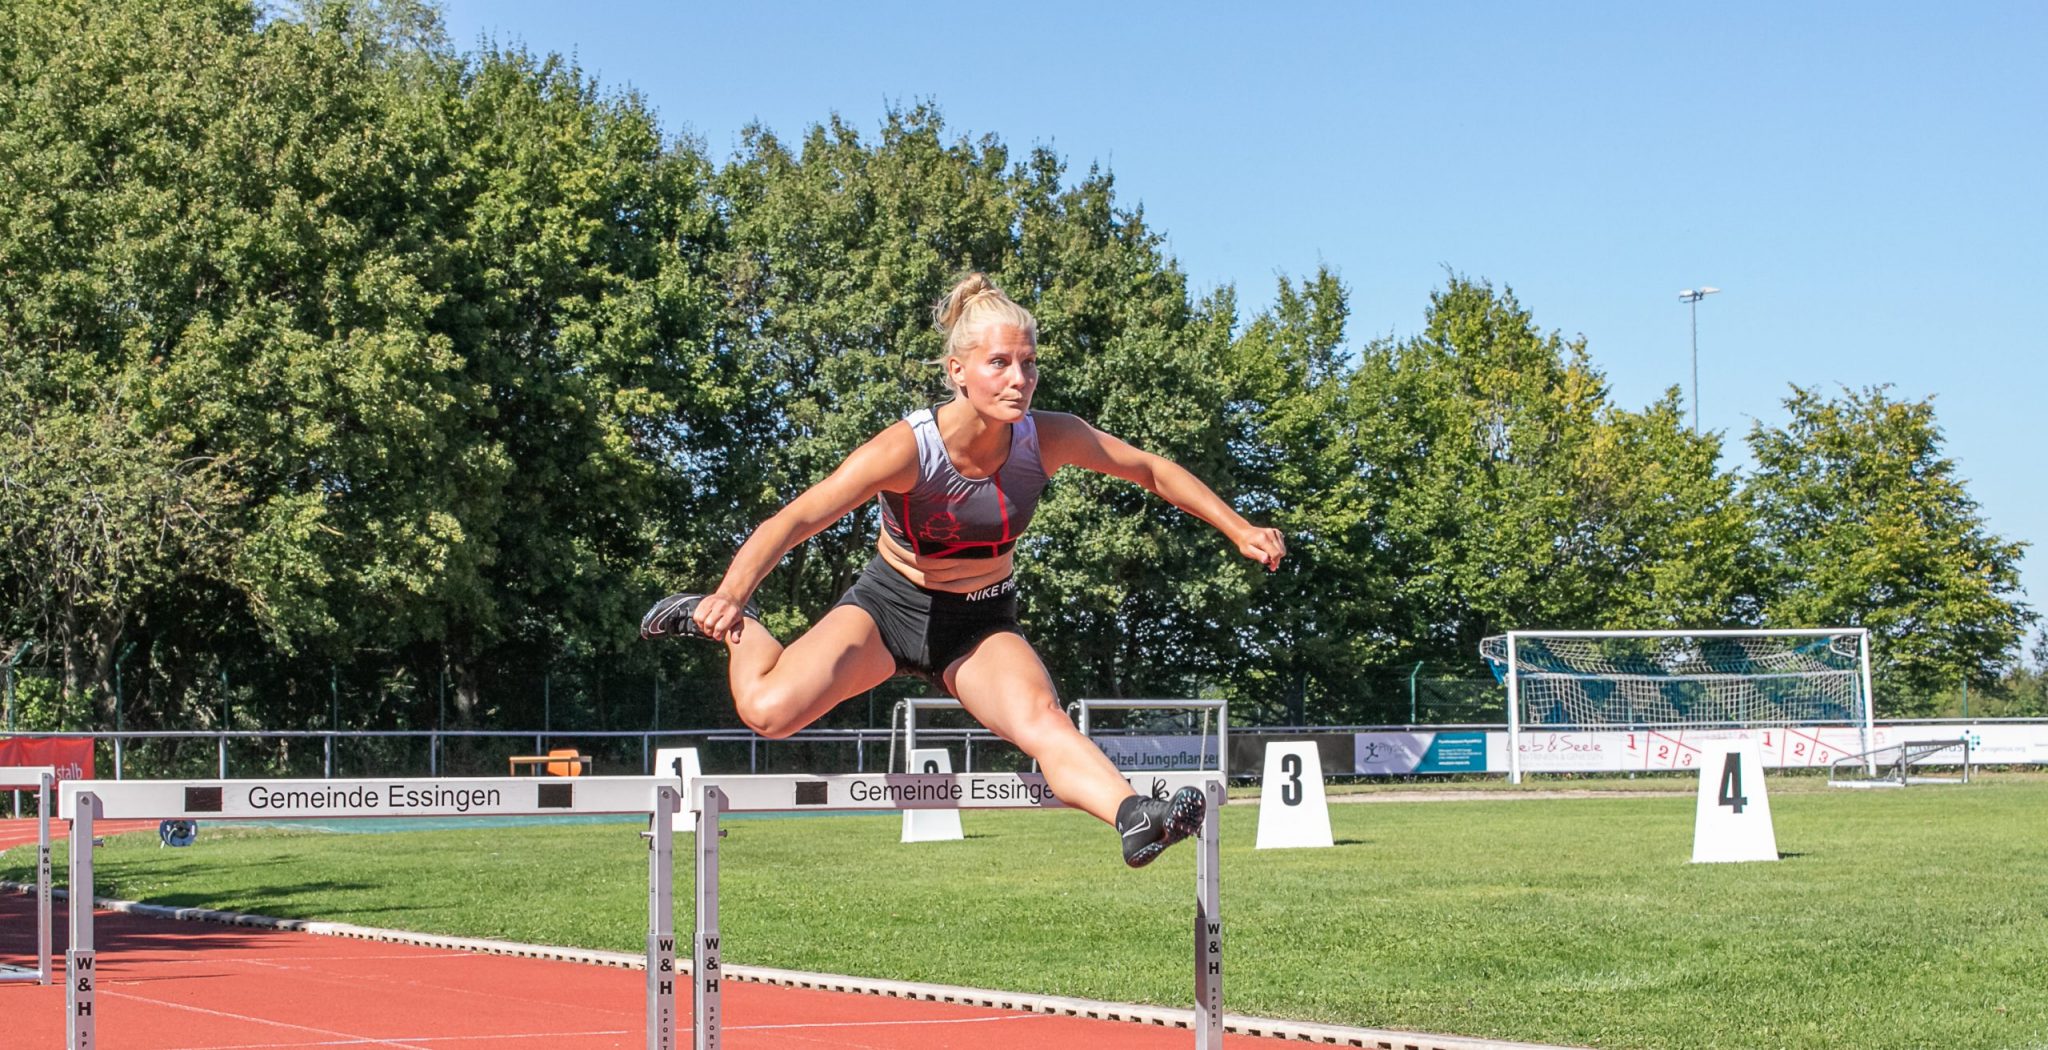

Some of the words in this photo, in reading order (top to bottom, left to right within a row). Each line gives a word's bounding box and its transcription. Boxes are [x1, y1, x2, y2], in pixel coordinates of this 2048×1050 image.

[966, 585, 1000, 602] NIKE
[1001, 579, 1016, 594] PR
[1547, 732, 1558, 753] &
[1560, 732, 1603, 752] Seele
[1627, 734, 1636, 750] 1
[1794, 742, 1805, 757] 2
[1109, 752, 1138, 767] elzel
[1658, 745, 1669, 760] 2
[1682, 753, 1692, 767] 3
[1819, 750, 1829, 764] 3
[56, 762, 83, 781] stalb
[671, 757, 684, 799] 1
[1281, 753, 1303, 807] 3
[849, 779, 963, 801] Gemeinde
[970, 778, 1055, 805] Essinge
[1718, 752, 1748, 814] 4
[248, 785, 379, 809] Gemeinde
[388, 784, 501, 812] Essingen
